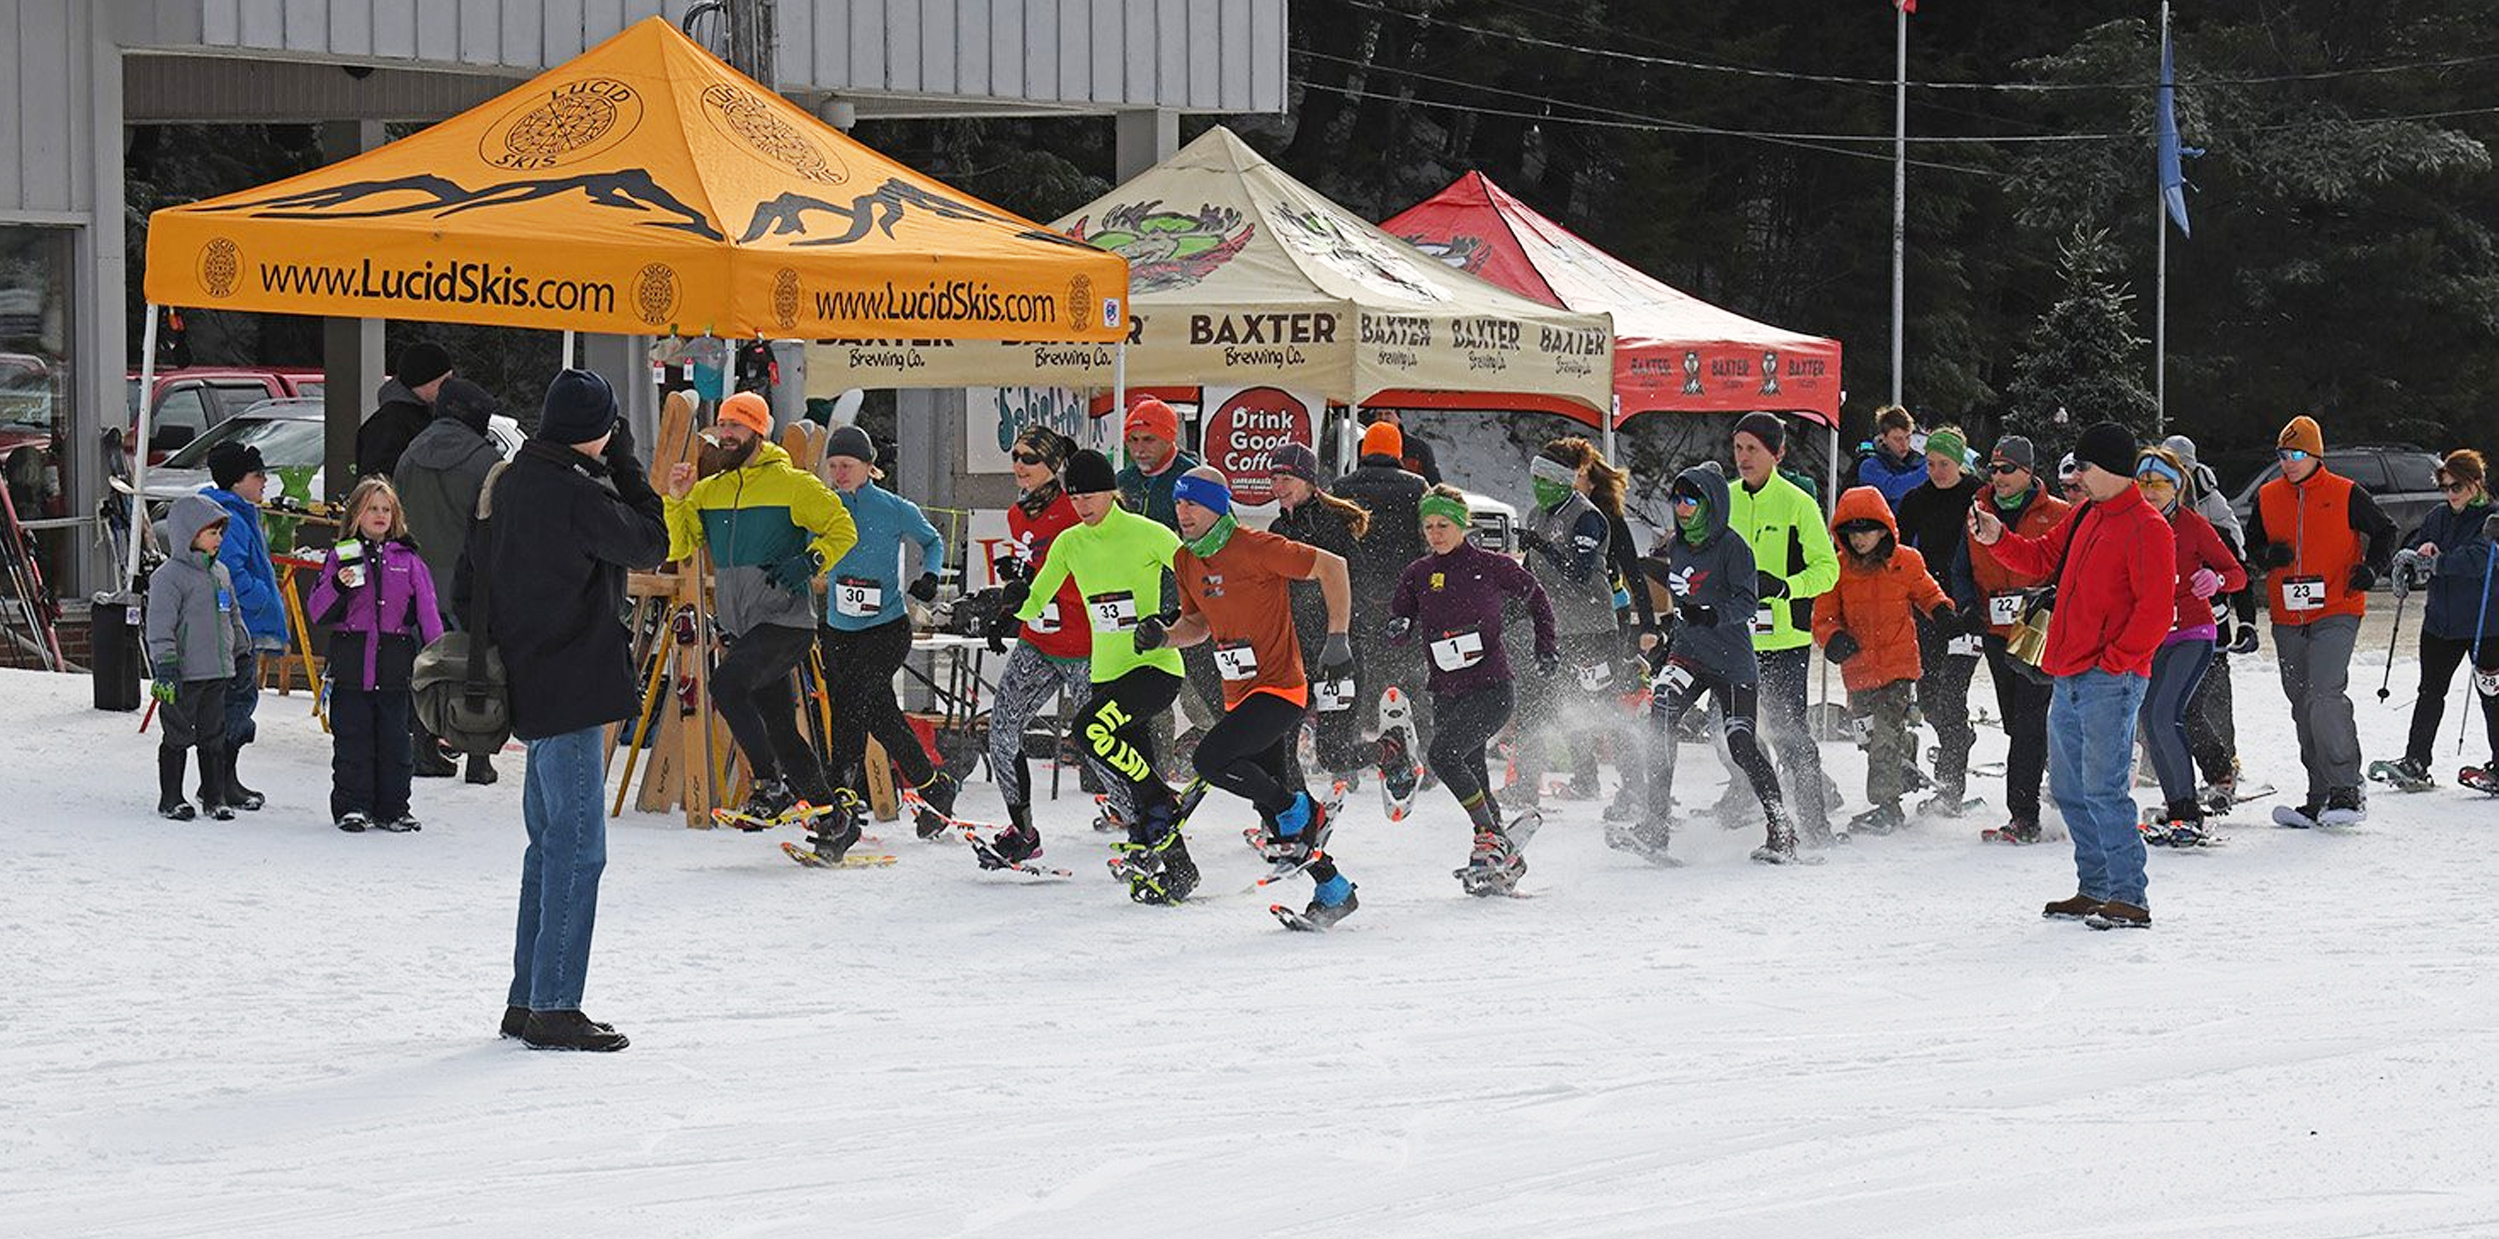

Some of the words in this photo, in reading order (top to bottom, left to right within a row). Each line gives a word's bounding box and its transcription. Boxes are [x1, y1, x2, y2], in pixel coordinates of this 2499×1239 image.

[552, 81, 631, 102] LUCID
[495, 154, 557, 168] SKIS
[642, 265, 672, 277] LUCID
[260, 258, 614, 313] www.LucidSkis.com
[816, 281, 1055, 322] www.LucidSkis.com
[1190, 313, 1336, 345] BAXTER
[1452, 319, 1521, 350] BAXTER
[850, 349, 904, 371] Brewing
[907, 349, 925, 368] Co.
[1035, 347, 1090, 370] Brewing
[1093, 347, 1112, 366] Co.
[1224, 346, 1283, 369] Brewing
[1286, 345, 1305, 365] Co.
[1788, 359, 1825, 377] BAXTER
[1232, 406, 1294, 429] Drink
[1229, 431, 1291, 451] Good
[1224, 451, 1272, 471] Coff
[846, 588, 865, 603] 30
[2293, 585, 2310, 598] 23
[1100, 604, 1119, 619] 33
[1997, 598, 2013, 612] 22
[1450, 640, 1458, 654] 1
[1221, 652, 1240, 667] 34
[2481, 676, 2496, 687] 28
